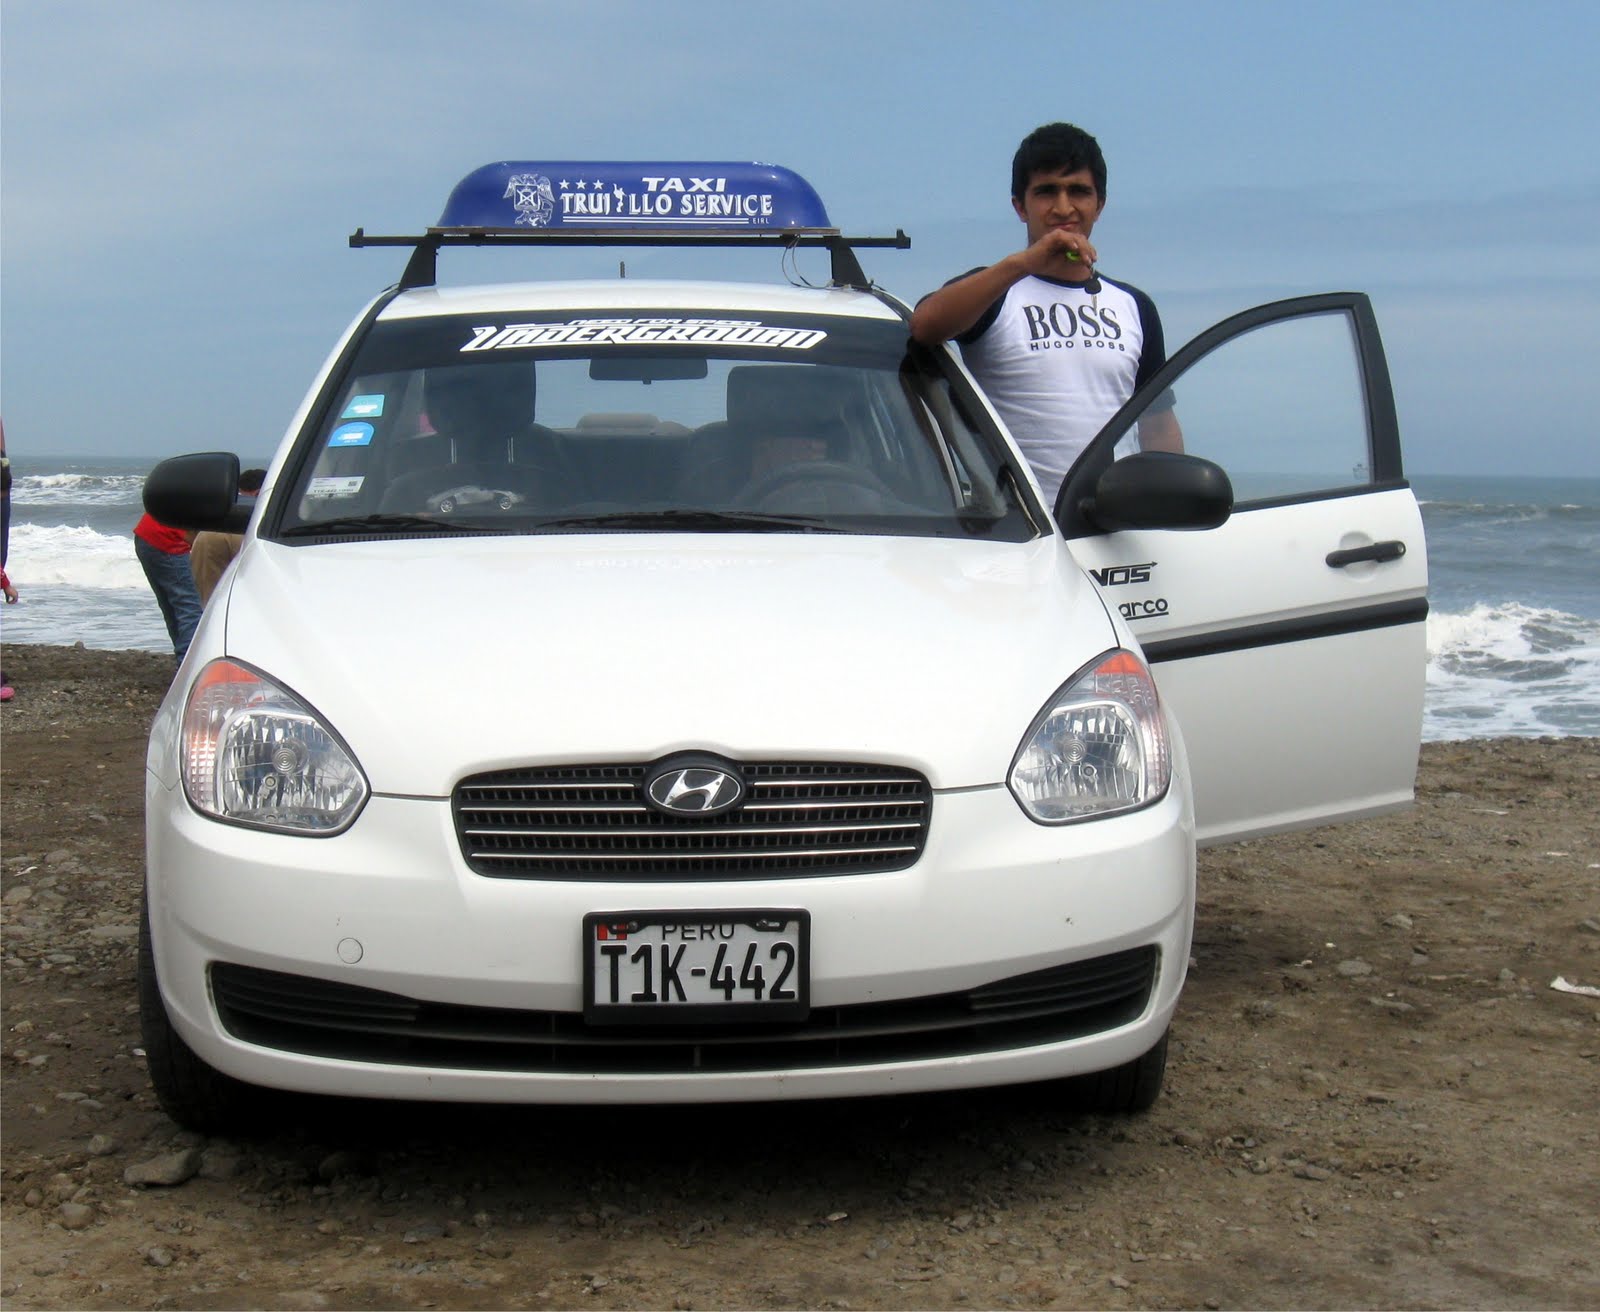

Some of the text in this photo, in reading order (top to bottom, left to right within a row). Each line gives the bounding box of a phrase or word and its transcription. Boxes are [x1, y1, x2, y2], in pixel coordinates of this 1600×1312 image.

[642, 177, 727, 192] TAXI
[680, 193, 773, 216] SERVICE
[1023, 302, 1122, 341] BOSS
[460, 323, 828, 352] UNDERGROUND
[1030, 339, 1125, 352] HUGO BOSS
[661, 923, 736, 941] PERU
[600, 942, 796, 1003] T1K-442
